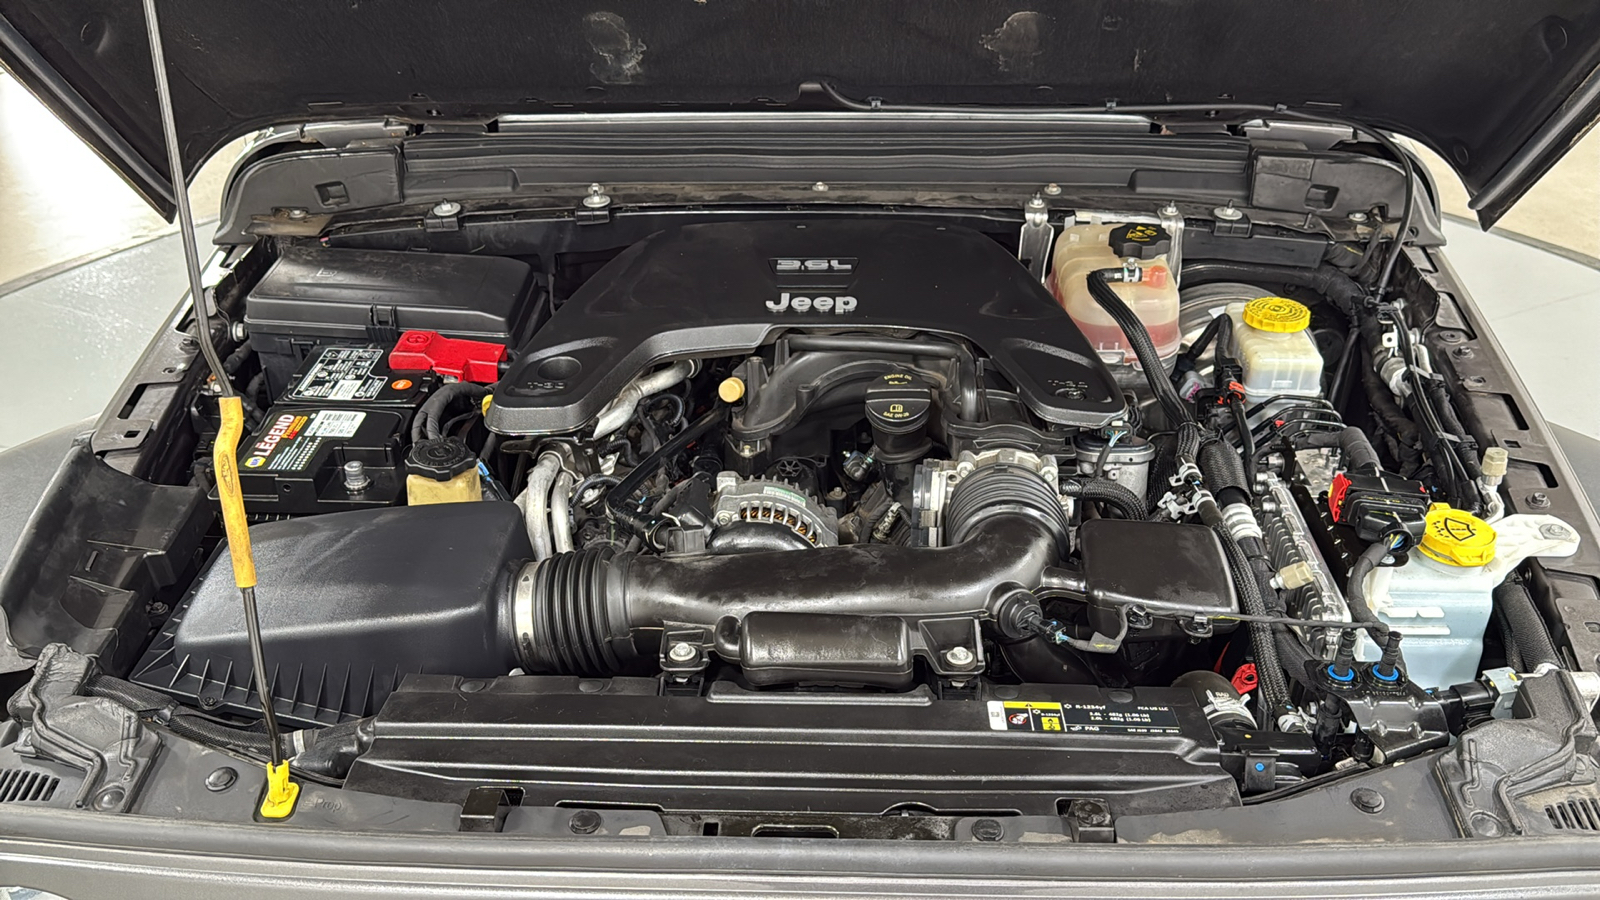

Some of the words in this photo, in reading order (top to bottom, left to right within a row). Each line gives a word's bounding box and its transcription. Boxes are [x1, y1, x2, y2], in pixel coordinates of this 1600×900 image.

[776, 259, 852, 270] 3.6L
[765, 292, 858, 315] Jeep
[253, 414, 295, 457] LEGEND
